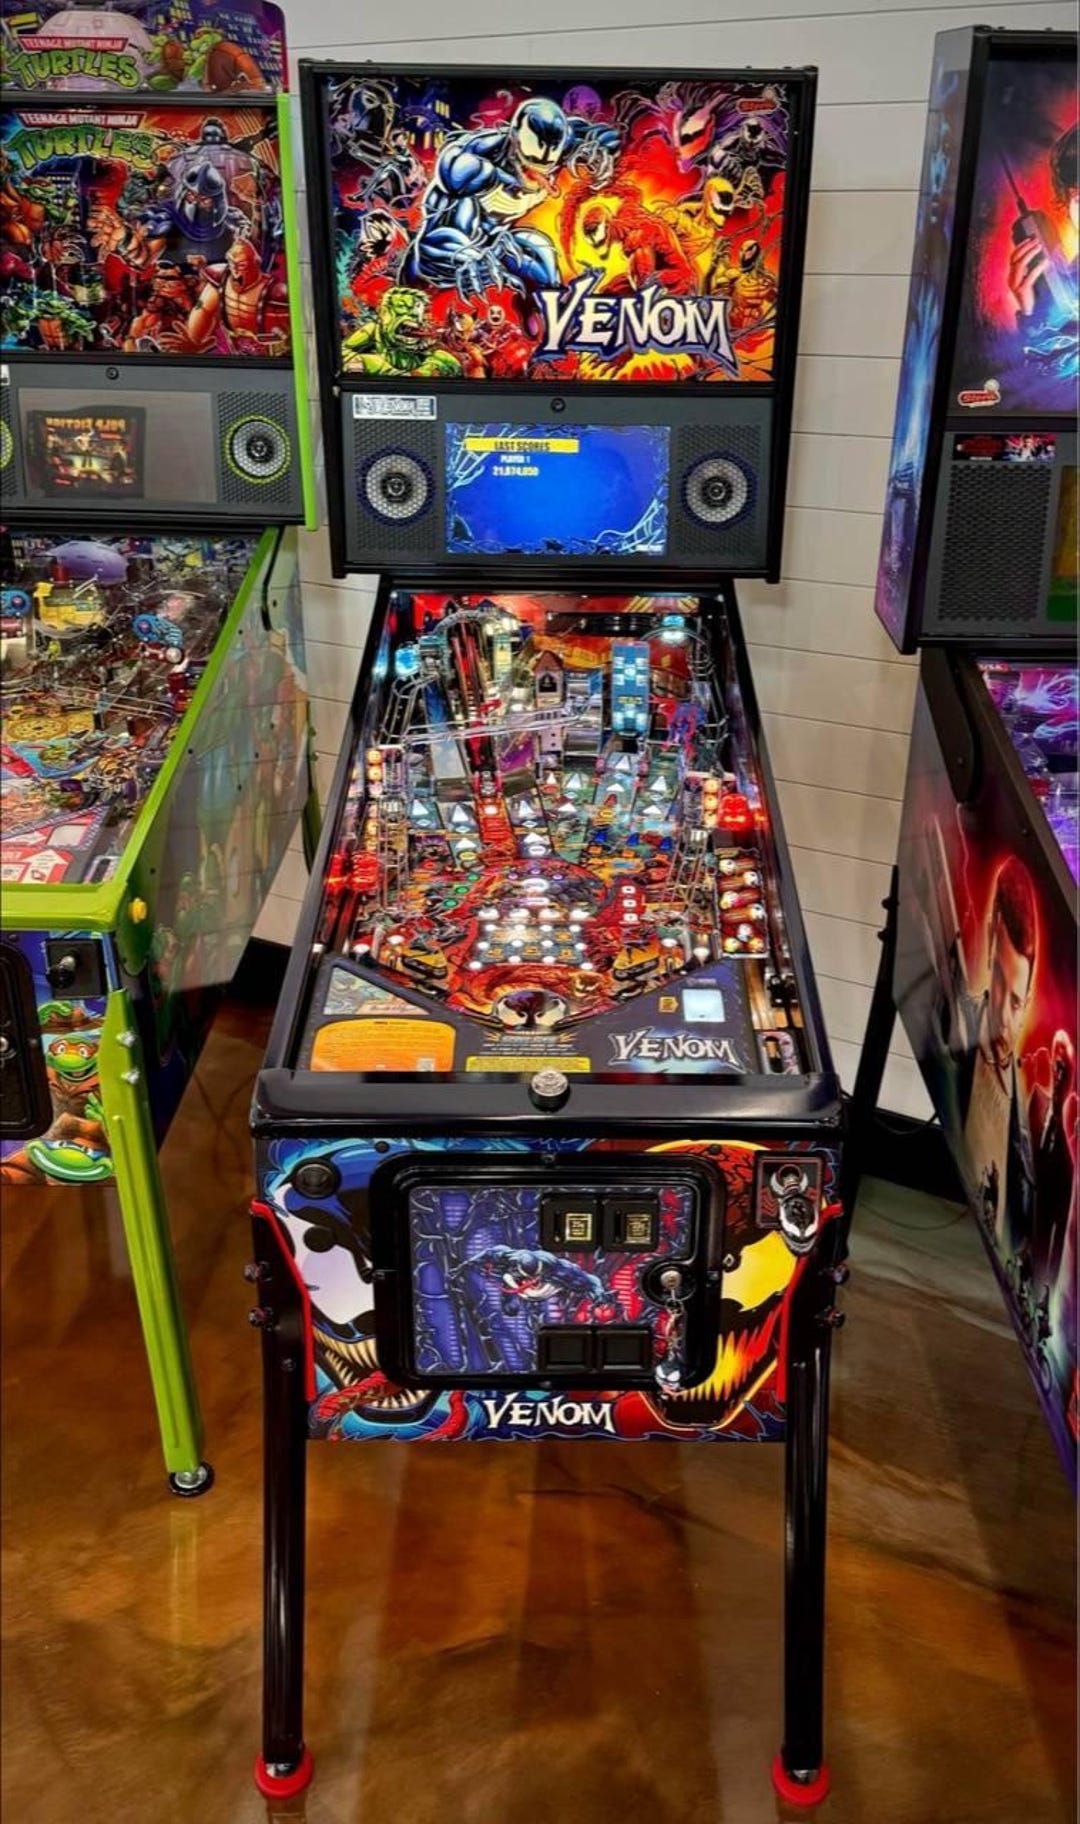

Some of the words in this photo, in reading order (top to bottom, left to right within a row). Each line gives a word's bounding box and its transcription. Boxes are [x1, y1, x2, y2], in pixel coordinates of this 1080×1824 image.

[8, 47, 140, 88] TURTLES
[20, 113, 68, 124] TEENAGE
[69, 114, 105, 125] MUTANT
[107, 114, 138, 126] NINJA
[5, 124, 155, 169] TURTLES
[537, 273, 739, 366] VENOM
[494, 440, 514, 450] LAST
[516, 441, 550, 451] SCORES
[612, 1028, 742, 1068] VENOM
[482, 1391, 617, 1434] VENOM
